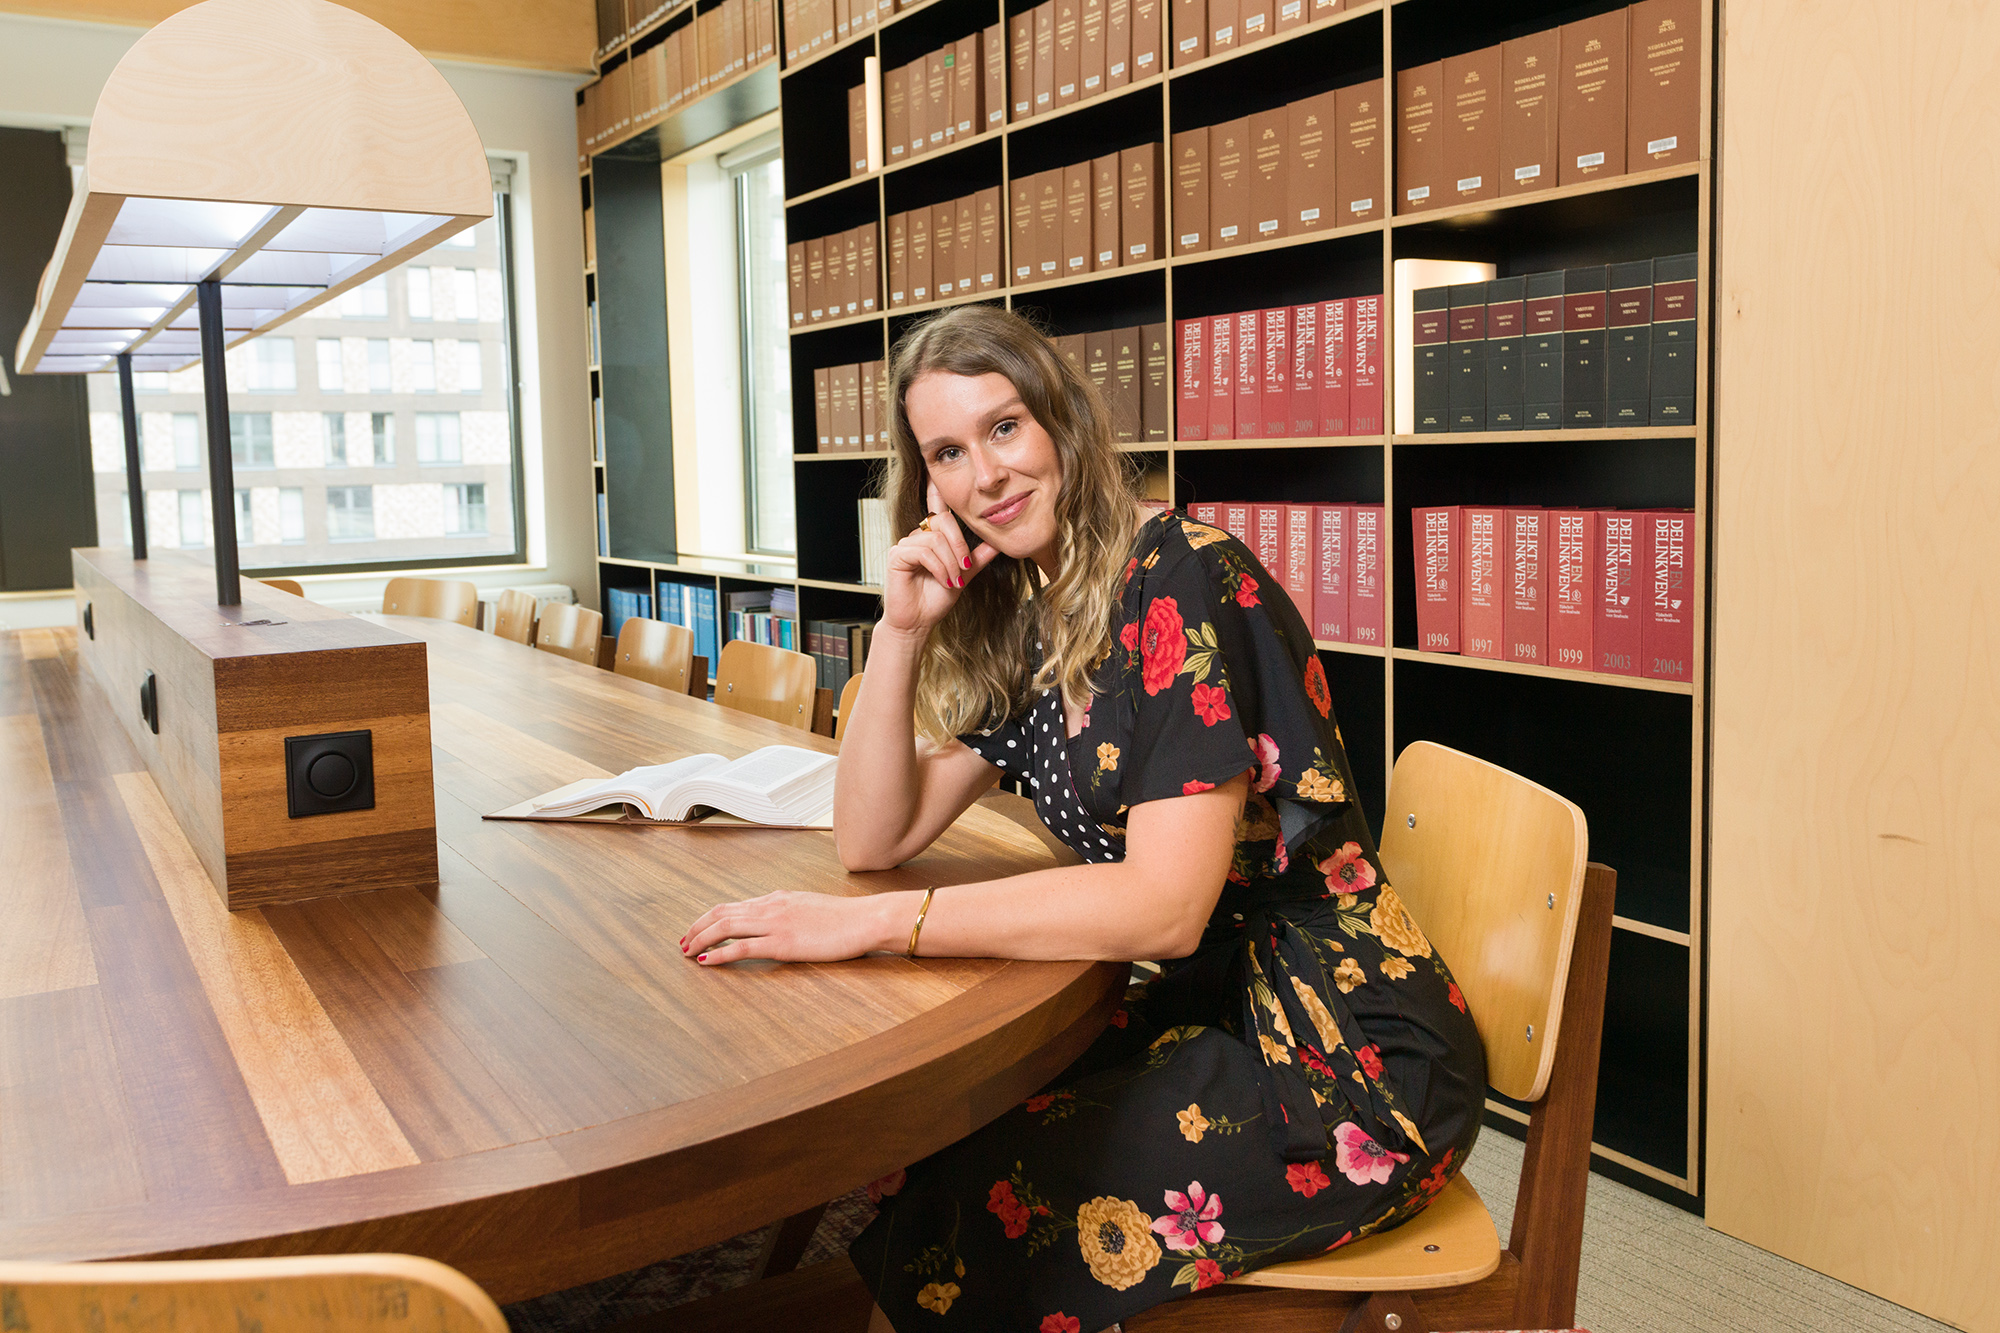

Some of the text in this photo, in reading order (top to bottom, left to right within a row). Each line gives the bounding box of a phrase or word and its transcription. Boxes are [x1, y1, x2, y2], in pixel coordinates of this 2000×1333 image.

[1193, 322, 1201, 358] DELIKT
[1222, 318, 1230, 354] DELIKT
[1266, 311, 1275, 382] DELINKWENT
[1276, 310, 1285, 349] DELIKT
[1296, 307, 1306, 379] DELINKWENT
[1306, 306, 1315, 345] DELIKT
[1325, 303, 1334, 377] DELINKWENT
[1335, 302, 1343, 342] DELIKT
[1356, 299, 1366, 375] DELINKWENT
[1367, 298, 1377, 339] DELIKT
[1184, 324, 1192, 389] DELINKWENT
[1214, 319, 1222, 386] DELINKWENT
[1240, 315, 1248, 384] DELINKWENT
[1240, 422, 1256, 434] 2007
[1267, 422, 1285, 434] 2008
[1295, 420, 1313, 432] 2009
[1325, 418, 1343, 431] 2010
[1356, 417, 1375, 430] 2011
[1260, 509, 1268, 568] DELINKWE
[1269, 509, 1277, 563] DELIKT EN
[1290, 510, 1298, 581] DELINKWENT
[1298, 511, 1306, 565] DELIKT EN
[1322, 510, 1331, 583] DELINKWENT
[1332, 511, 1341, 567] DELIKT EN
[1357, 512, 1366, 586] DELINKWENT
[1367, 512, 1376, 570] DELIKT EN
[1426, 513, 1437, 590] DELINKWENT
[1438, 512, 1448, 572] DELIKT EN
[1472, 514, 1482, 594] DELINKWENT
[1482, 514, 1493, 577] DELIKT EN
[1515, 515, 1527, 598] DELINKWENT
[1527, 516, 1539, 580] DELIKT EN
[1559, 516, 1570, 601] DELINKWENT
[1571, 516, 1583, 583] DELIKT EN
[1606, 518, 1618, 605] DELINKWENT
[1619, 518, 1632, 586] DELIKT EN
[1655, 519, 1669, 609] DELINKWENT
[1670, 519, 1684, 589] DELIKT EN
[1321, 623, 1340, 636] 1994
[1357, 627, 1376, 640] 1995
[1426, 633, 1449, 647] 1996
[1471, 638, 1492, 653] 1997
[1514, 643, 1536, 658] 1998
[1558, 648, 1583, 665] 1999
[1603, 653, 1631, 670] 2003
[1653, 658, 1683, 676] 2004
